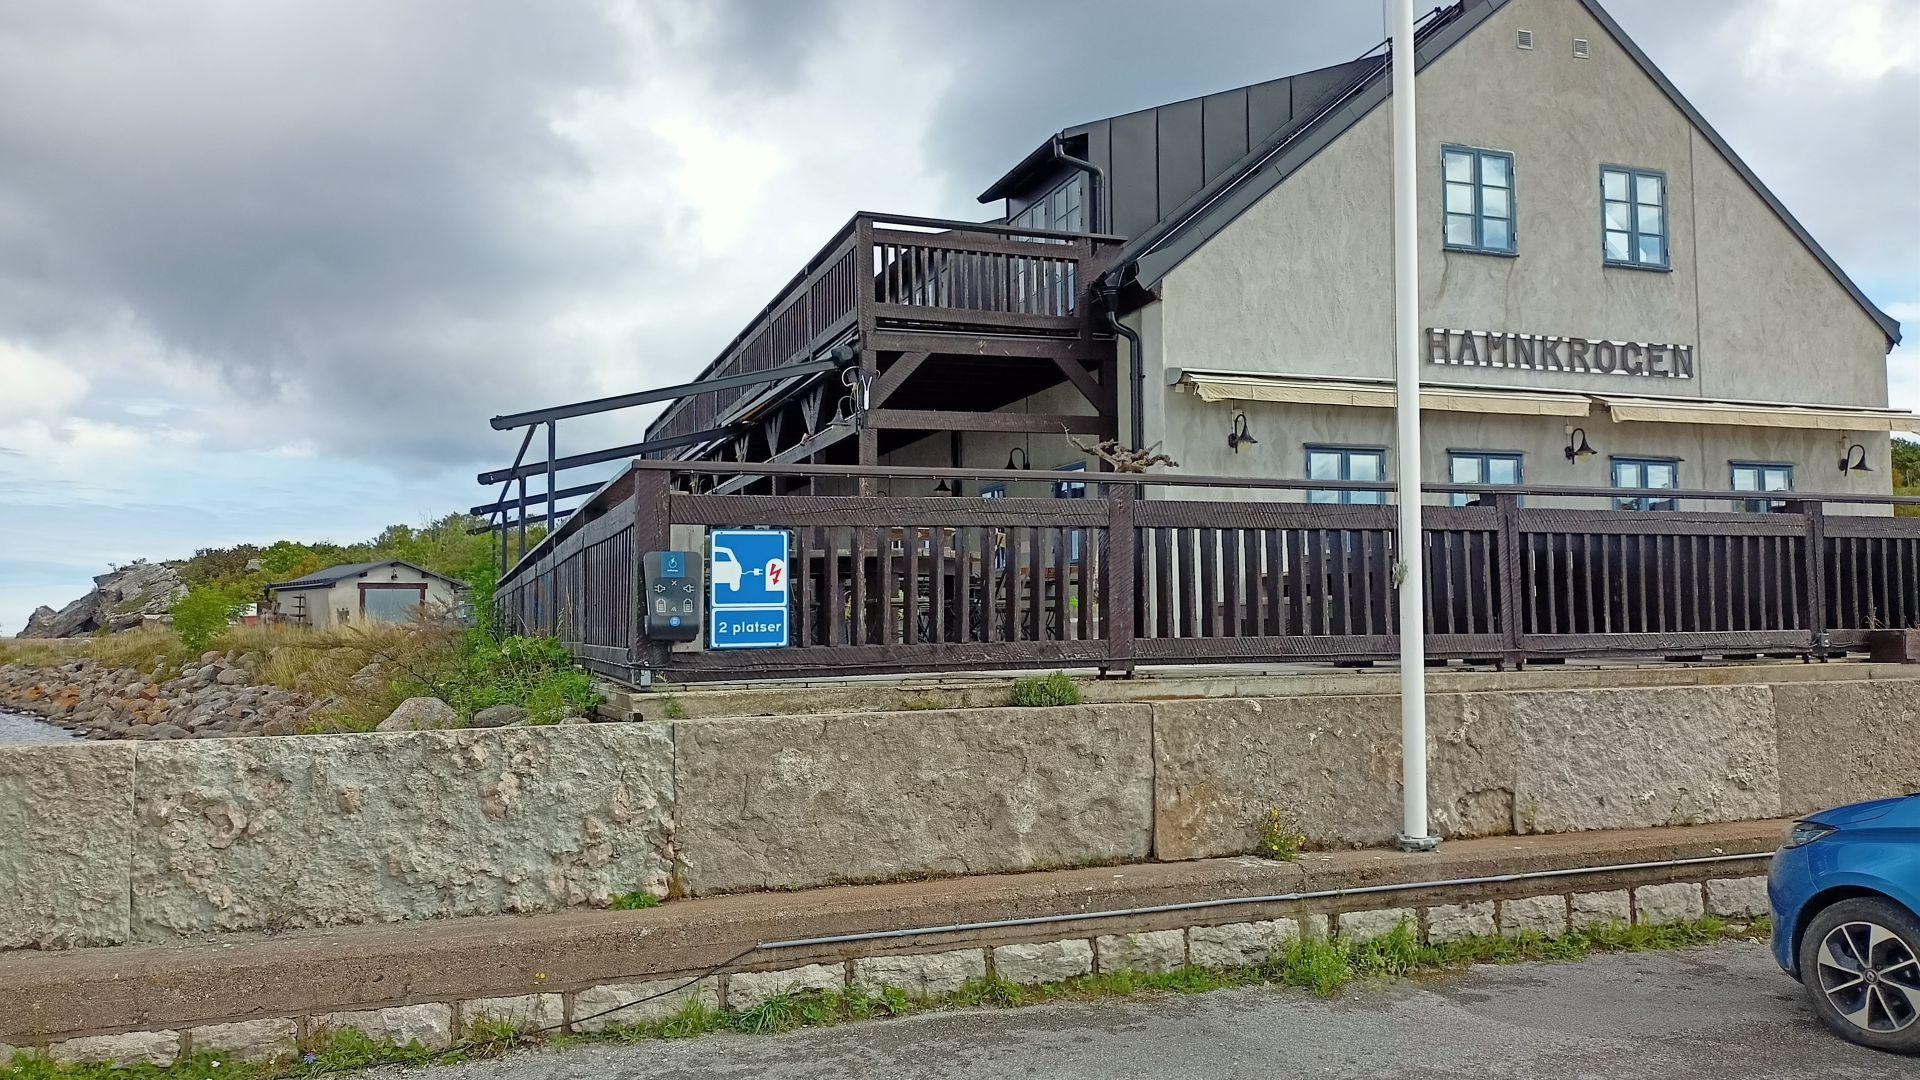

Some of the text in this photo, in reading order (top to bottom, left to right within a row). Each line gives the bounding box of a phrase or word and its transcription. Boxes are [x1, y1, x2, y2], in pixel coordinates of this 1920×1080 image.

[1426, 327, 1693, 378] HAMNKROGEN
[718, 621, 782, 636] 2 platser
